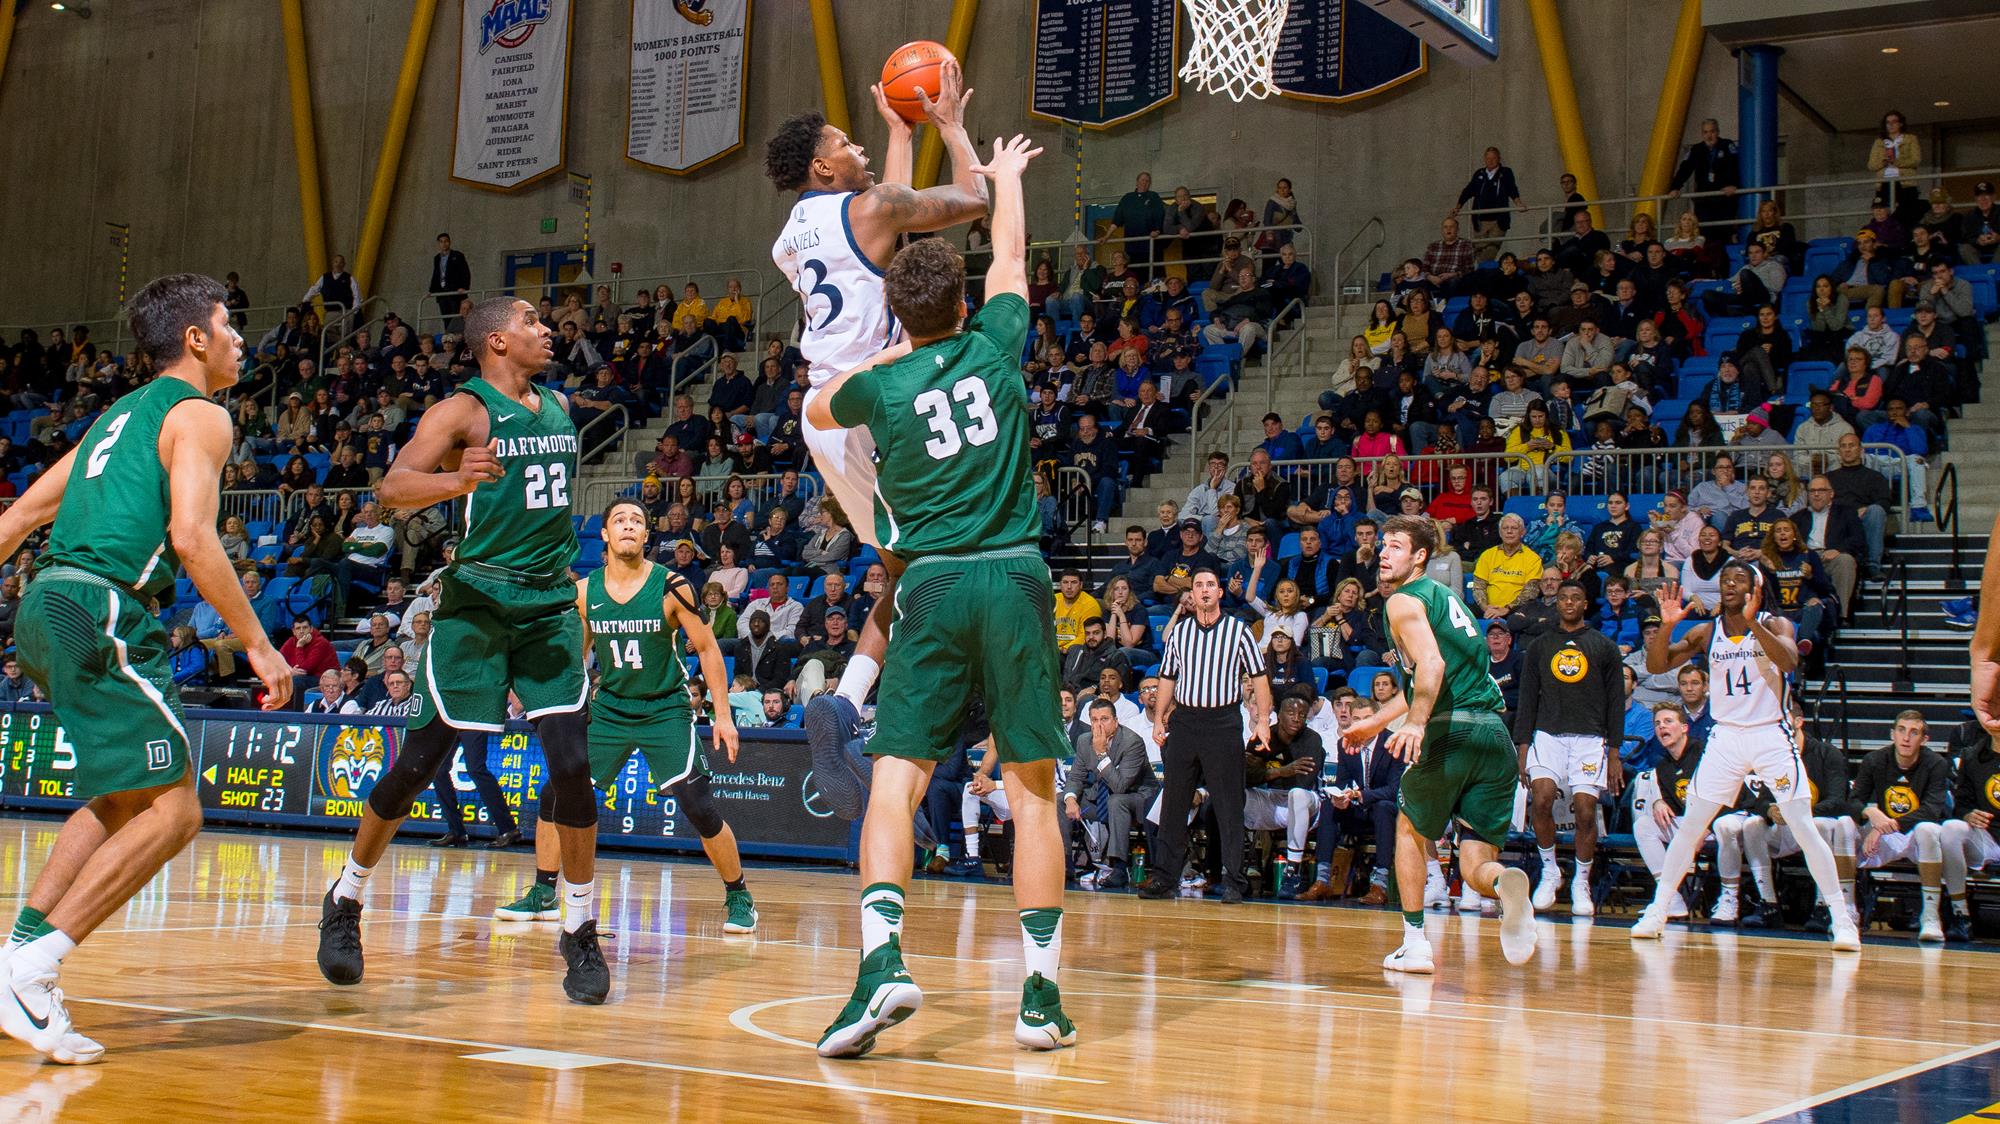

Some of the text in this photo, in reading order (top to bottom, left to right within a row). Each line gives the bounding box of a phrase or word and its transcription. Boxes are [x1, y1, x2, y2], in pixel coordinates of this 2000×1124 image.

[481, 0, 551, 50] MAAC
[633, 28, 743, 51] WOMEN'S BASKETBALL
[495, 52, 533, 64] CANISIUS
[654, 44, 721, 61] 1000 POINTS
[491, 63, 534, 76] FAIRFIELD
[502, 77, 523, 87] IONA
[485, 87, 538, 100] MANHATTAN
[495, 100, 528, 110] MARIST
[486, 111, 535, 123] MONMOUTH
[491, 122, 529, 134] NIAGARA
[485, 134, 534, 146] QUINNIPIAC
[496, 147, 522, 156] RIDER
[478, 157, 538, 170] SAINT PETER'S
[496, 170, 520, 179] SIENA
[782, 227, 820, 256] DANIELS
[911, 374, 1000, 461] 33
[84, 410, 132, 480] 2
[495, 434, 578, 458] DARTMOUTH
[524, 462, 570, 511] 22
[1447, 595, 1478, 638] 4
[589, 619, 661, 634] DARTMOUTH
[609, 639, 643, 670] 14
[1712, 647, 1766, 663] Quinnipiac
[1725, 664, 1752, 697] 14
[30, 714, 41, 730] 0
[227, 725, 302, 765] 11:12
[12, 740, 24, 771] FLS
[26, 748, 36, 763] 3
[145, 739, 172, 771] D
[501, 754, 522, 769] #11
[627, 758, 639, 775] 2
[227, 766, 285, 787] HALF 2
[498, 773, 523, 789] #13
[527, 764, 541, 801] PTS
[39, 779, 75, 796] TOL 2
[604, 777, 618, 811] AS
[625, 777, 637, 795] 0
[221, 787, 286, 811] SHOT 23
[503, 791, 522, 808] 14
[722, 789, 744, 800] North
[745, 790, 770, 801] Haven
[410, 801, 442, 819] OL 2
[478, 806, 489, 822] 6
[664, 798, 677, 817] 0
[622, 816, 635, 834] 9
[662, 820, 675, 836] 2
